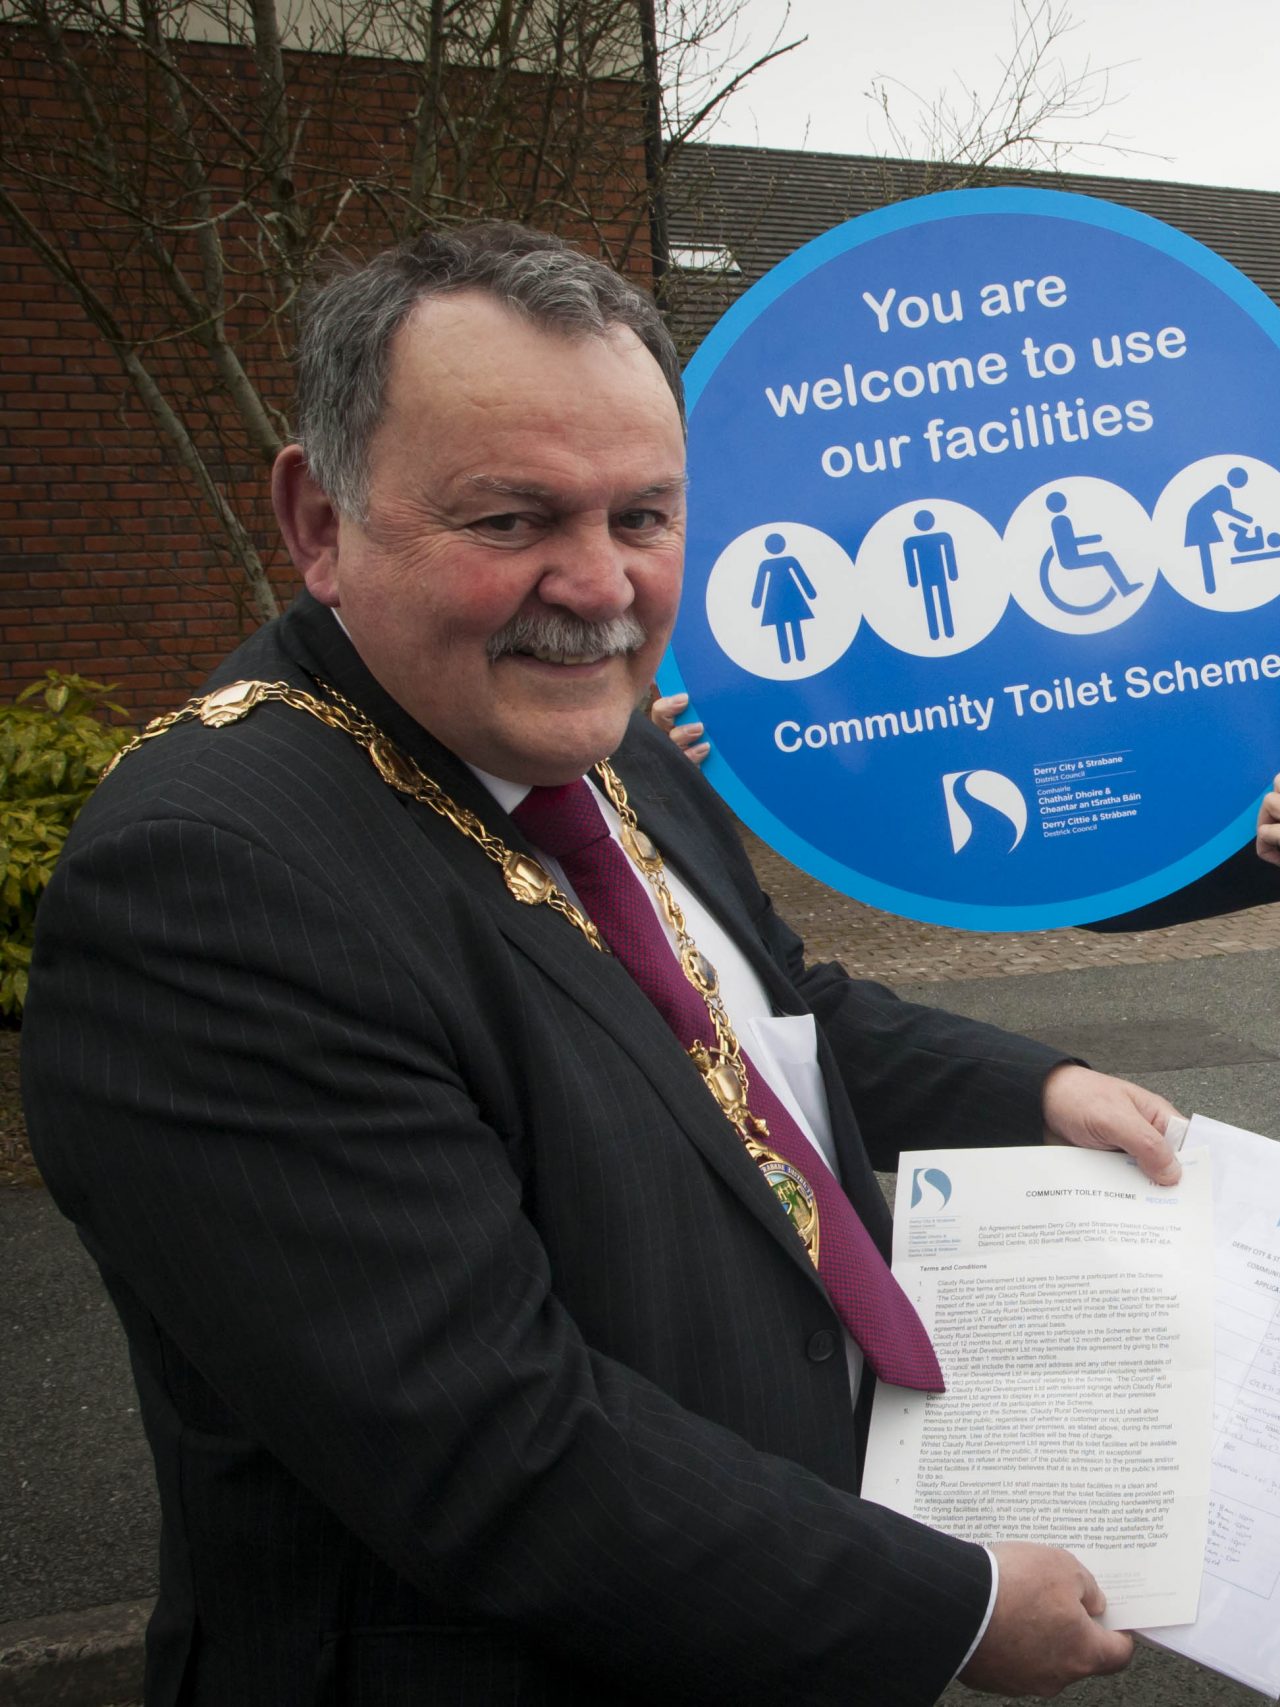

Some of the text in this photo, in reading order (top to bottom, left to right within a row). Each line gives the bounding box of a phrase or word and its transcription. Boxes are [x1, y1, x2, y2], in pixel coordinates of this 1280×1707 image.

[863, 276, 1066, 332] You are
[766, 327, 1186, 417] welcome to use
[822, 397, 1153, 477] our facilities
[775, 695, 993, 752] Community
[1004, 673, 1116, 715] Toilet
[1034, 767, 1057, 776] Derry
[1086, 756, 1123, 768] Strabane
[1035, 771, 1085, 784] District Council
[1037, 786, 1071, 796] Comhairle
[1039, 794, 1074, 805] Chathair
[1076, 789, 1103, 799] Dhoire
[1040, 803, 1077, 814] Cheantar
[1091, 797, 1121, 807] tSratha
[1123, 793, 1141, 801] Báin
[1042, 820, 1066, 829] Derry
[1068, 816, 1090, 825] Cittie
[1092, 814, 1098, 822] &
[1044, 824, 1097, 838] Destrick Cooncil
[1026, 1189, 1072, 1197] COMMUNITY
[1104, 1192, 1136, 1200] SCHEME
[1232, 1240, 1252, 1254] DERRY
[1252, 1246, 1266, 1258] CITY
[920, 1264, 938, 1272] Terms
[953, 1262, 987, 1270] Conditions
